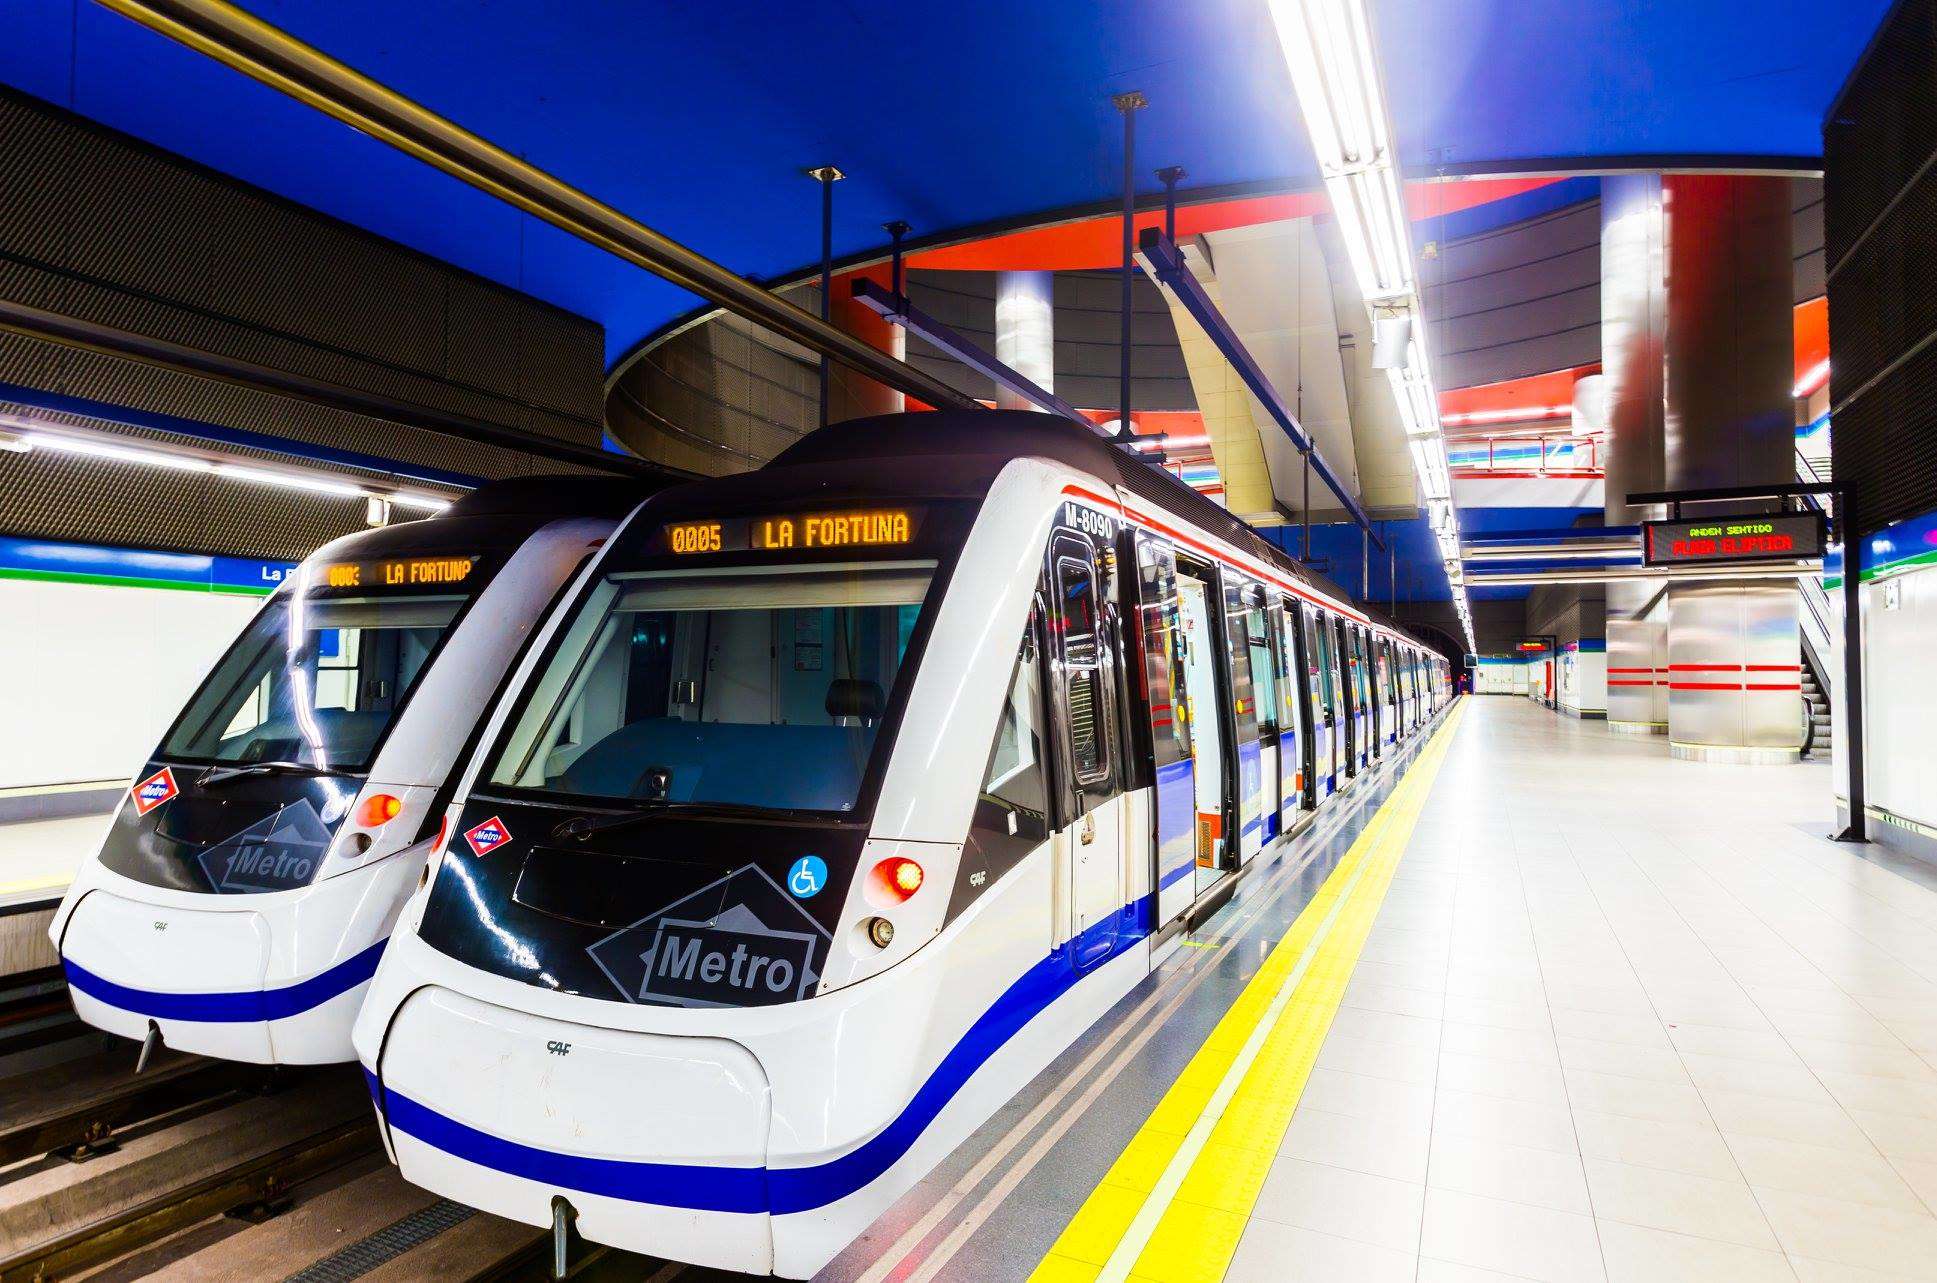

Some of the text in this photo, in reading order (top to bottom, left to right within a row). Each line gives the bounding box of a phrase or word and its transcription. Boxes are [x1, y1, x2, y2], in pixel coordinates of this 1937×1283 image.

[766, 515, 908, 547] LA FORTUNA
[1065, 502, 1112, 539] M-8090
[673, 525, 721, 552] 0005
[262, 566, 281, 581] La
[386, 564, 404, 584] LA
[142, 784, 168, 796] Metro
[475, 830, 499, 842] Metro
[234, 846, 311, 880] Metro
[657, 936, 794, 993] Metro
